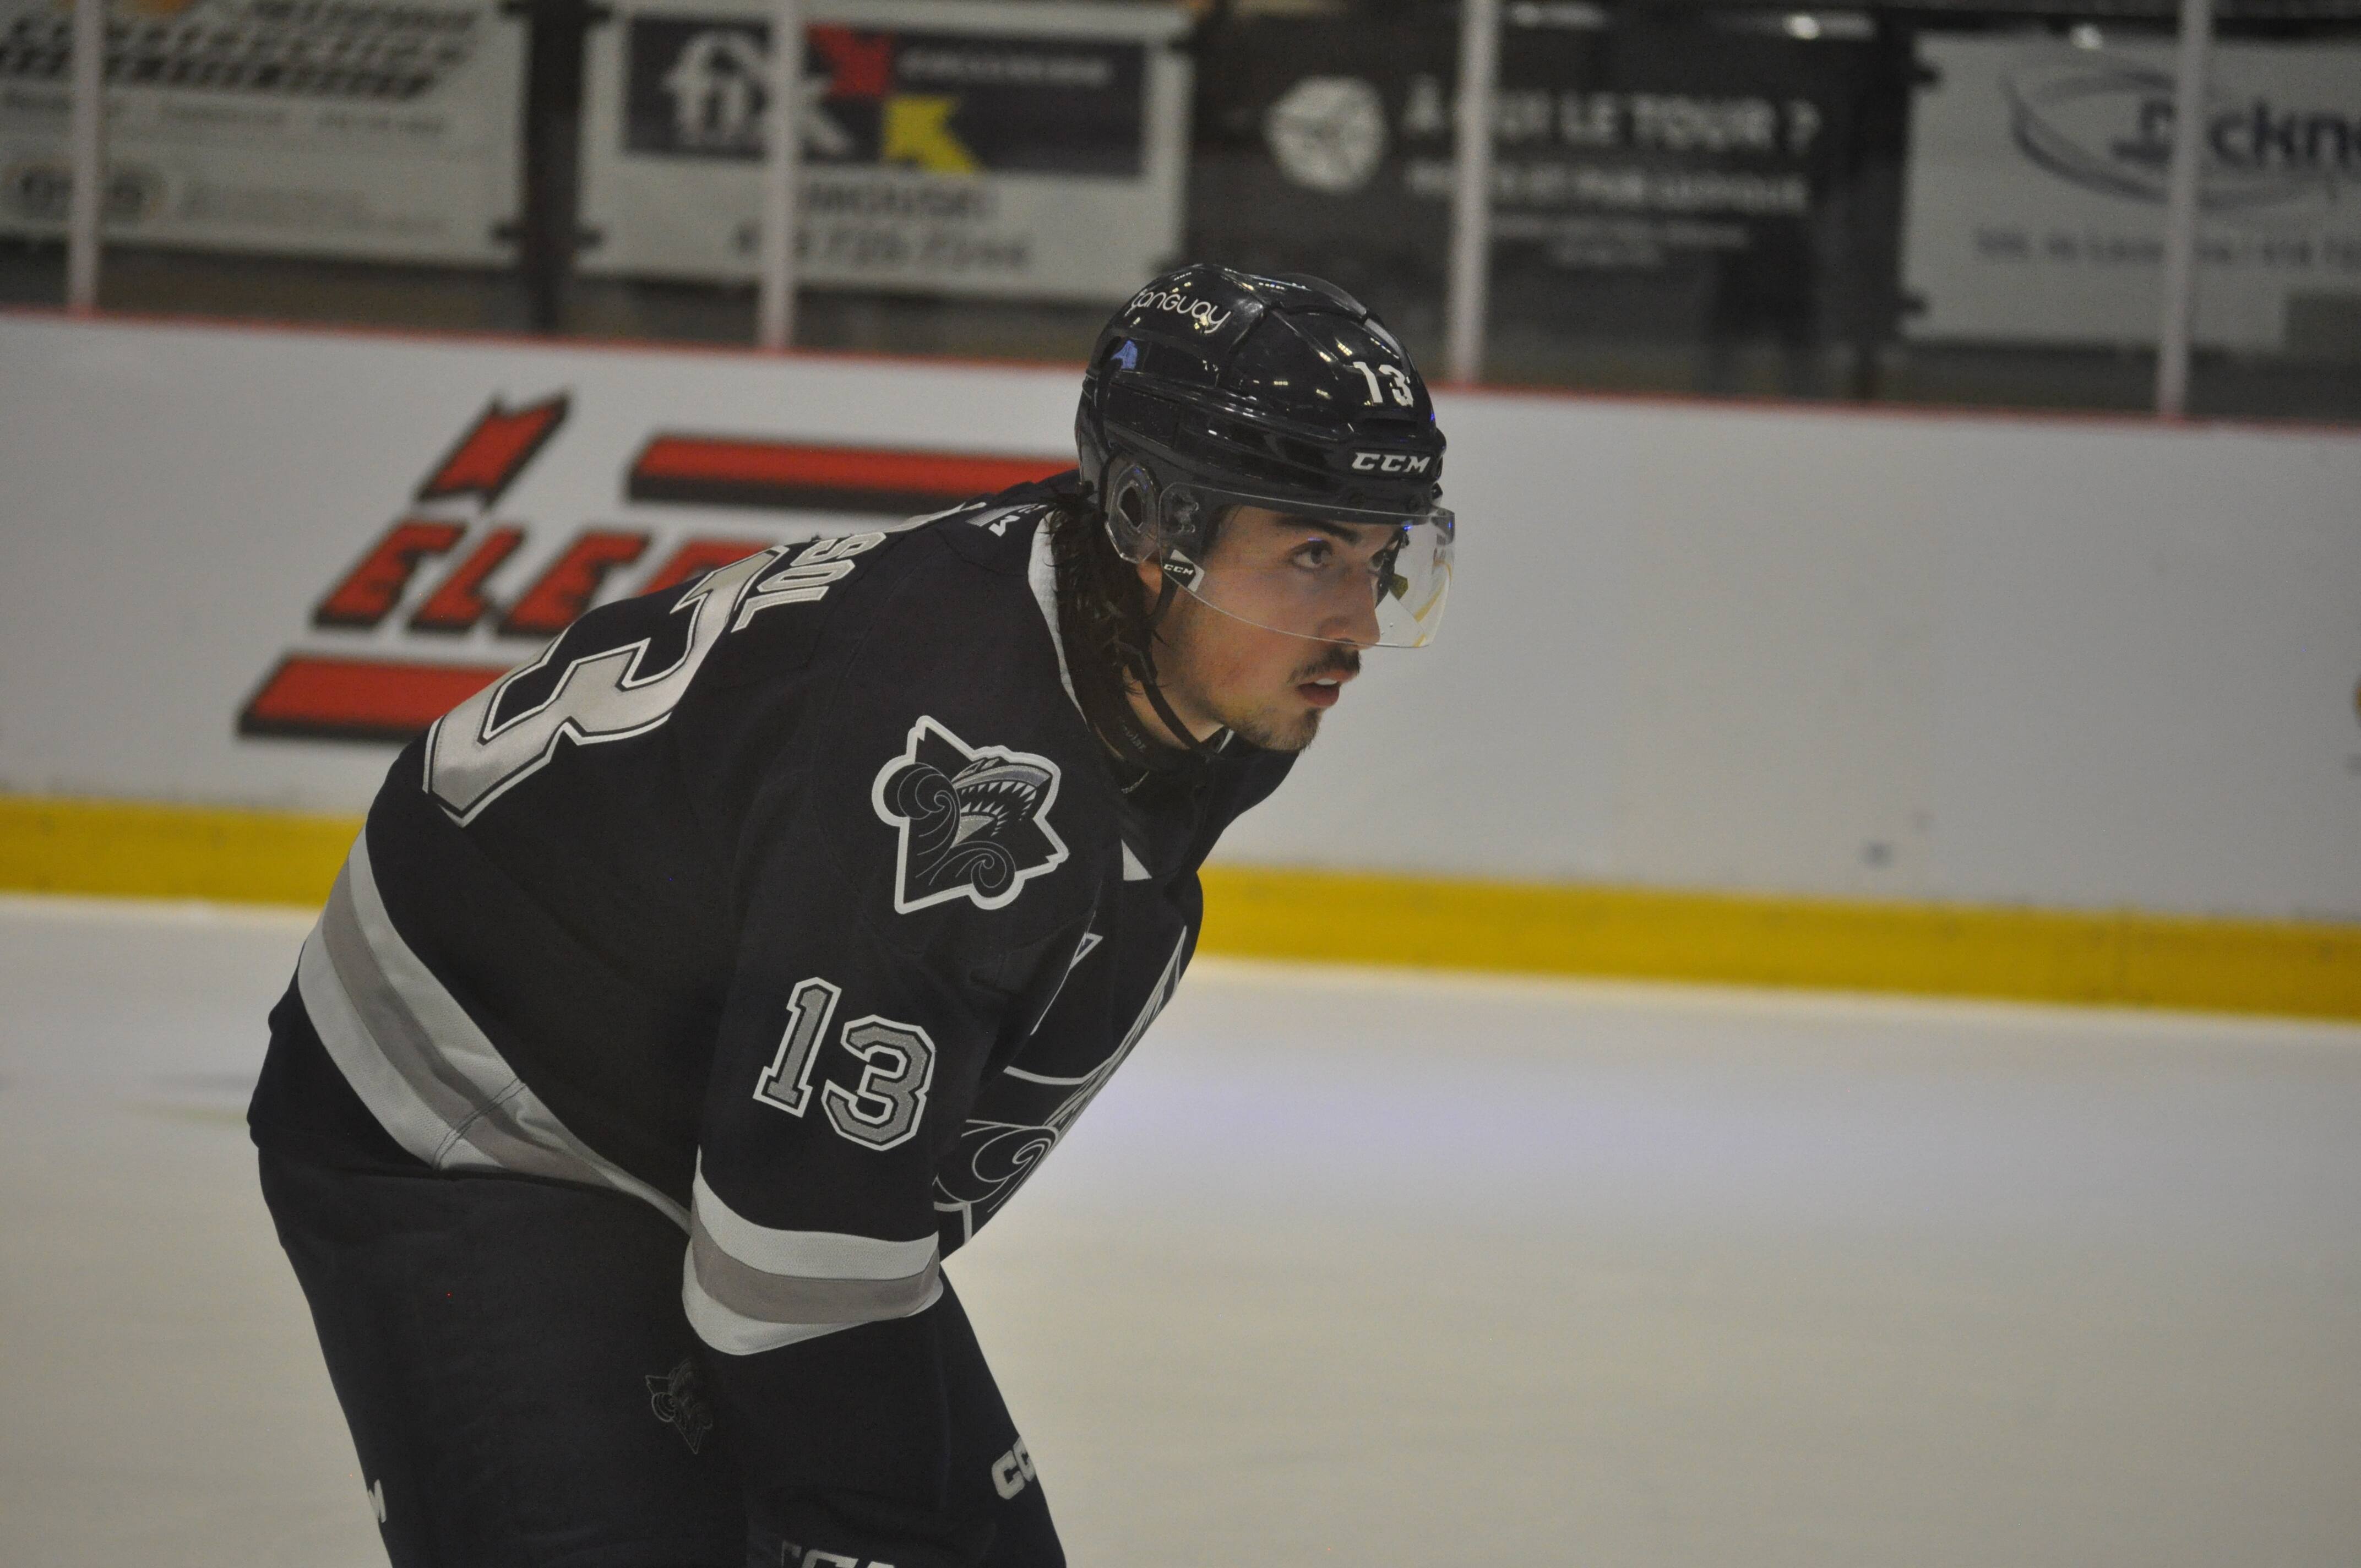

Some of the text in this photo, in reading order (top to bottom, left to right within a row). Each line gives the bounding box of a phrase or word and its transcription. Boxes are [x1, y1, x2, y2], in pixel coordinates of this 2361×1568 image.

[1559, 92, 1618, 144] LE
[1630, 95, 1775, 150] TOUR
[1352, 361, 1414, 407] 13
[1352, 452, 1430, 473] CCM
[1163, 563, 1194, 576] CCM
[753, 977, 935, 1151] 13
